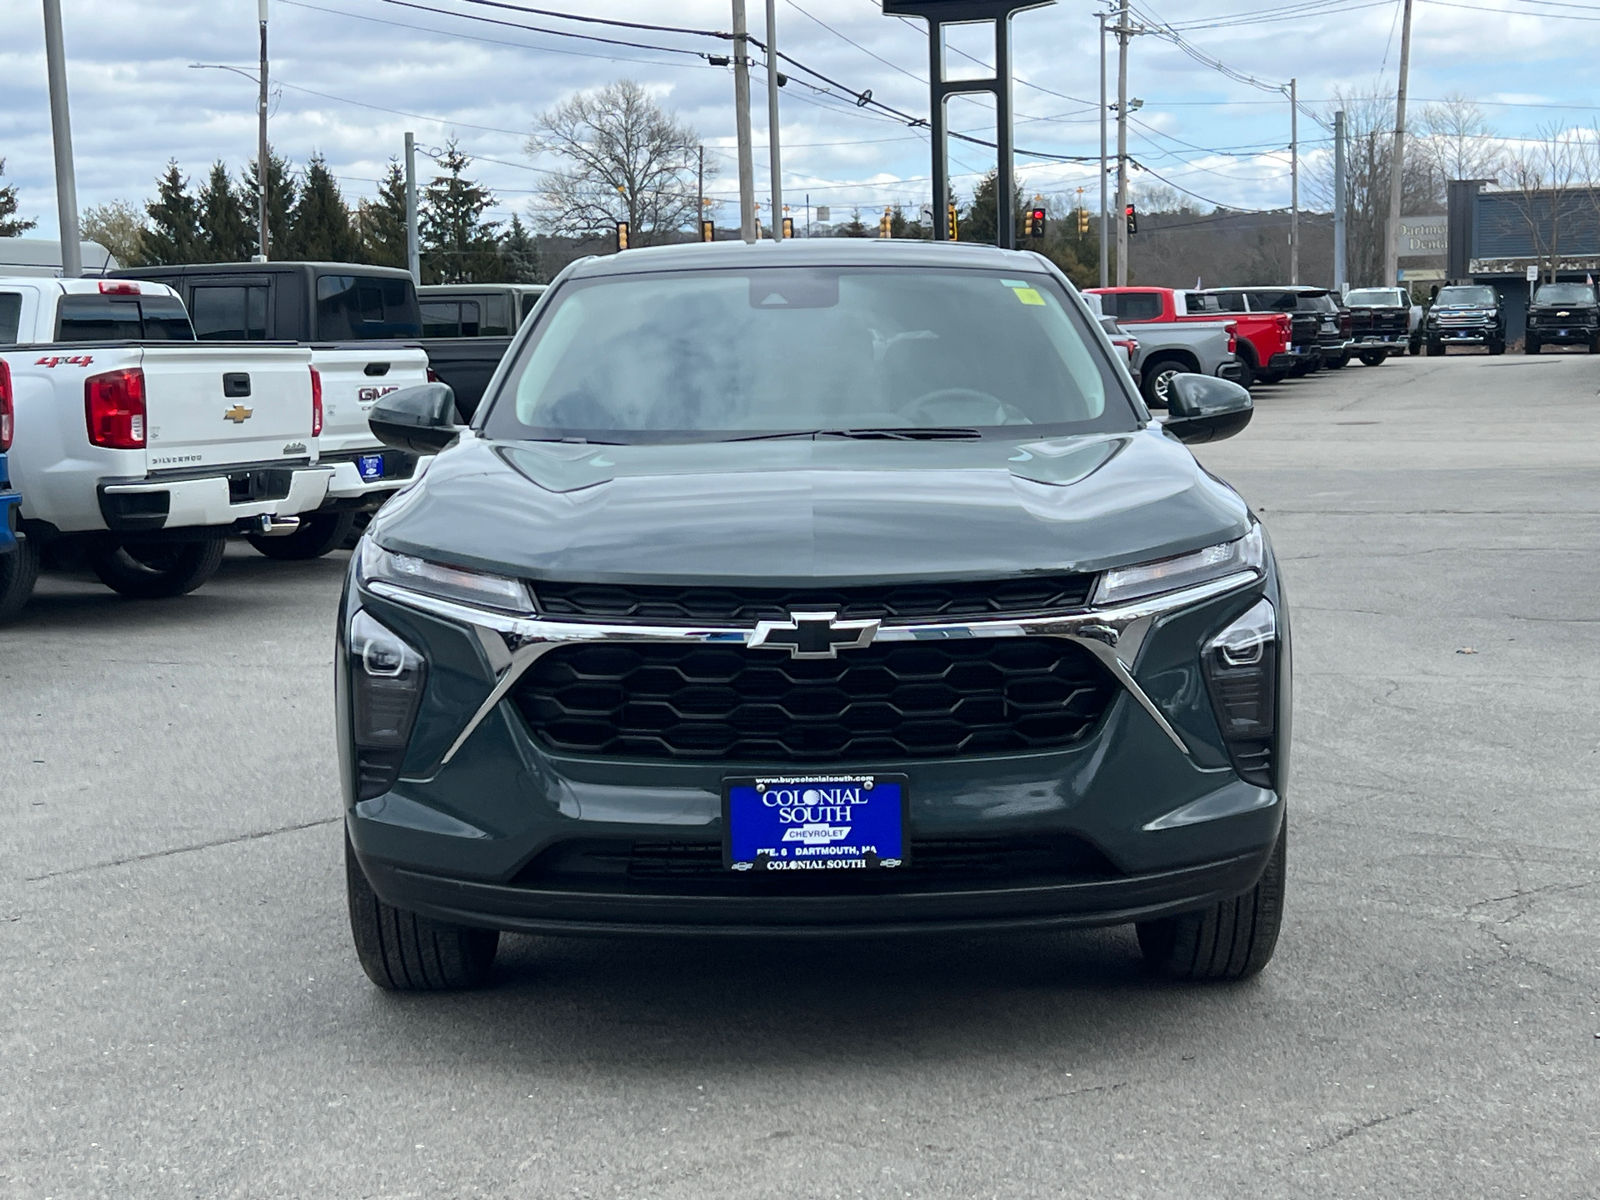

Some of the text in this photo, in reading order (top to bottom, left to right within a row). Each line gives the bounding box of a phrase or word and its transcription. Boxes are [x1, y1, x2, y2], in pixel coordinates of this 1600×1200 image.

[1409, 237, 1448, 250] Denta
[755, 776, 874, 784] www.buycolonialsouth.com
[762, 788, 868, 807] COLONIAL
[779, 806, 851, 823] SOUTH
[788, 829, 844, 838] CHEVROLET
[795, 846, 859, 856] DARTMOUTH,
[767, 859, 866, 869] COLONIAL SOUTH
